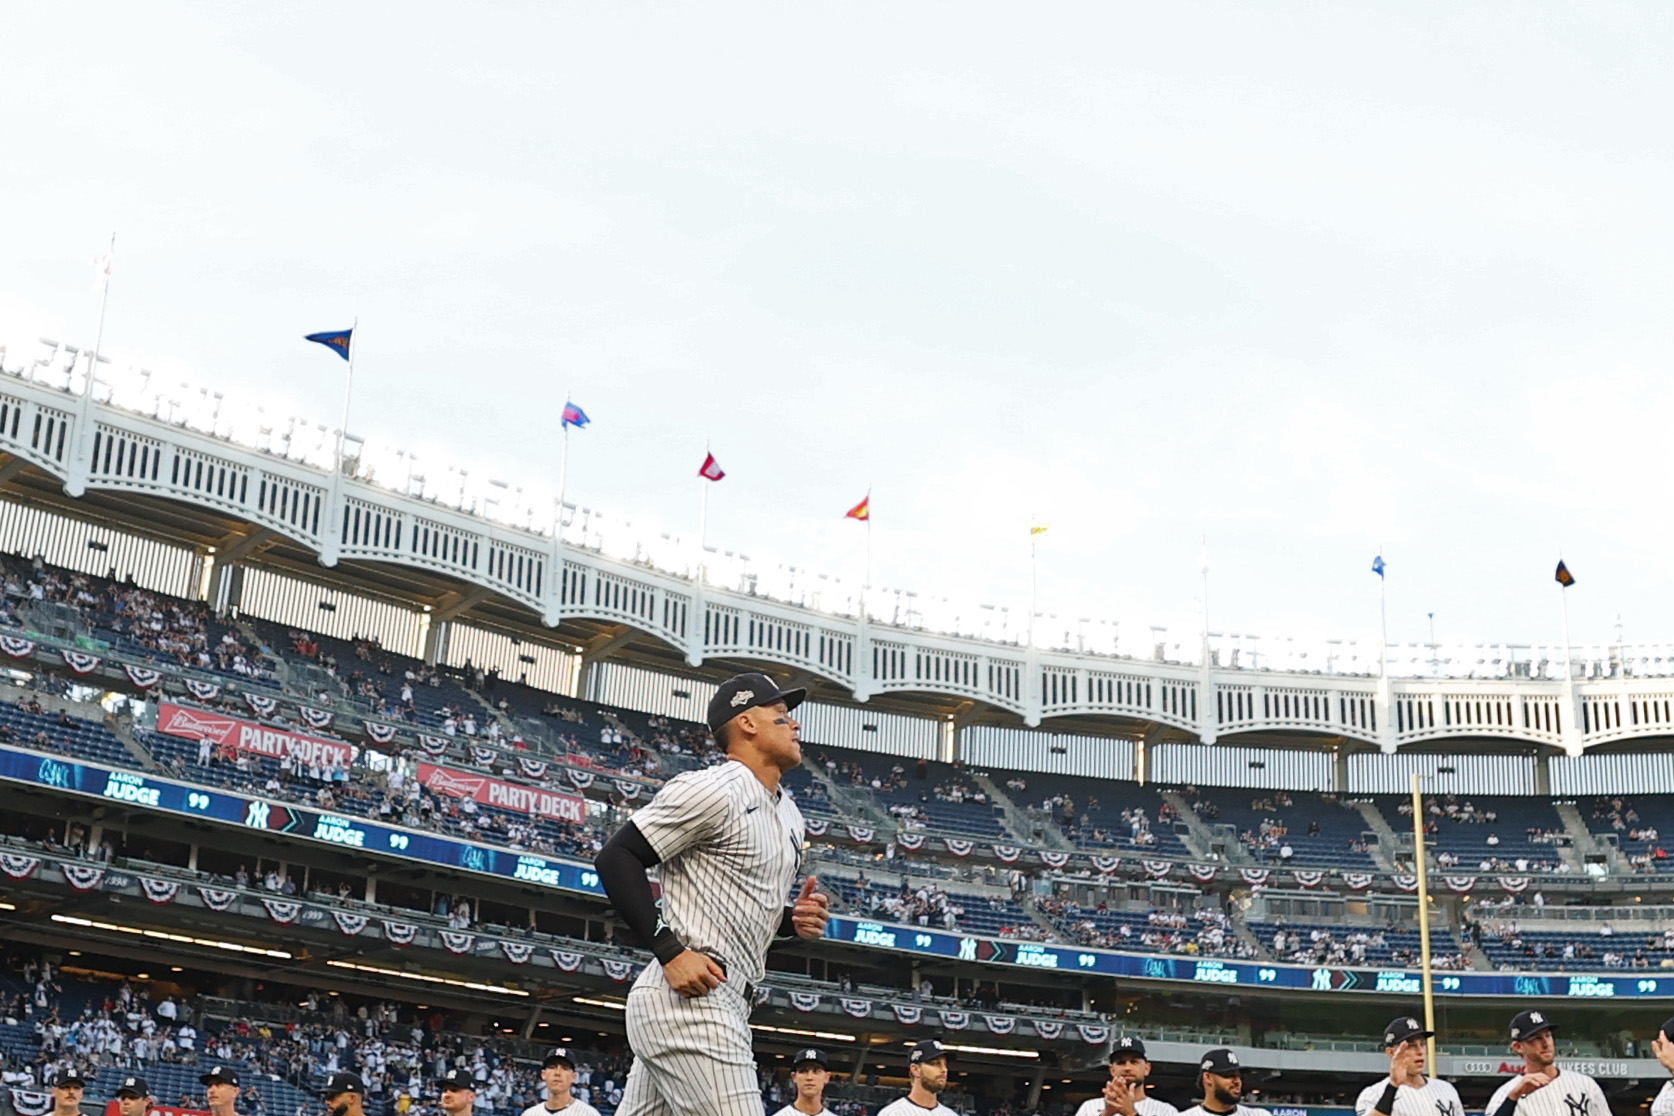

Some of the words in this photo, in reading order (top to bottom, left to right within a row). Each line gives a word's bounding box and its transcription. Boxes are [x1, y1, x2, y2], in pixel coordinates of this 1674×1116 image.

[173, 712, 228, 739] Budweiser
[240, 726, 296, 758] PARTY
[299, 739, 347, 767] DECK
[109, 771, 144, 786] AARON
[103, 780, 160, 806] JUDGE
[189, 793, 210, 809] 99
[488, 783, 538, 811] PARTY
[540, 795, 581, 821] DECK
[318, 814, 350, 828] AARON
[314, 824, 365, 847] JUDGE
[390, 834, 409, 849] 99
[518, 855, 547, 868] AARON
[514, 863, 560, 885] JUDGE
[581, 873, 599, 887] 99
[857, 922, 884, 932] AARON
[853, 930, 896, 947] JUDGE
[916, 934, 932, 948] 99
[1018, 944, 1045, 953] AARON
[1015, 951, 1058, 968] JUDGE
[1079, 954, 1096, 967] 99
[1196, 961, 1224, 970] AARON
[1194, 968, 1238, 983] JUDGE
[1259, 969, 1276, 981] 99
[1569, 976, 1599, 985] AARON
[1375, 978, 1420, 992] JUDGE
[1442, 977, 1460, 990] 99
[1568, 983, 1615, 996] JUDGE
[1638, 980, 1657, 993] 99
[1497, 1062, 1526, 1074] Au
[1554, 1062, 1595, 1075] NKEES
[1599, 1063, 1628, 1075] CLUB
